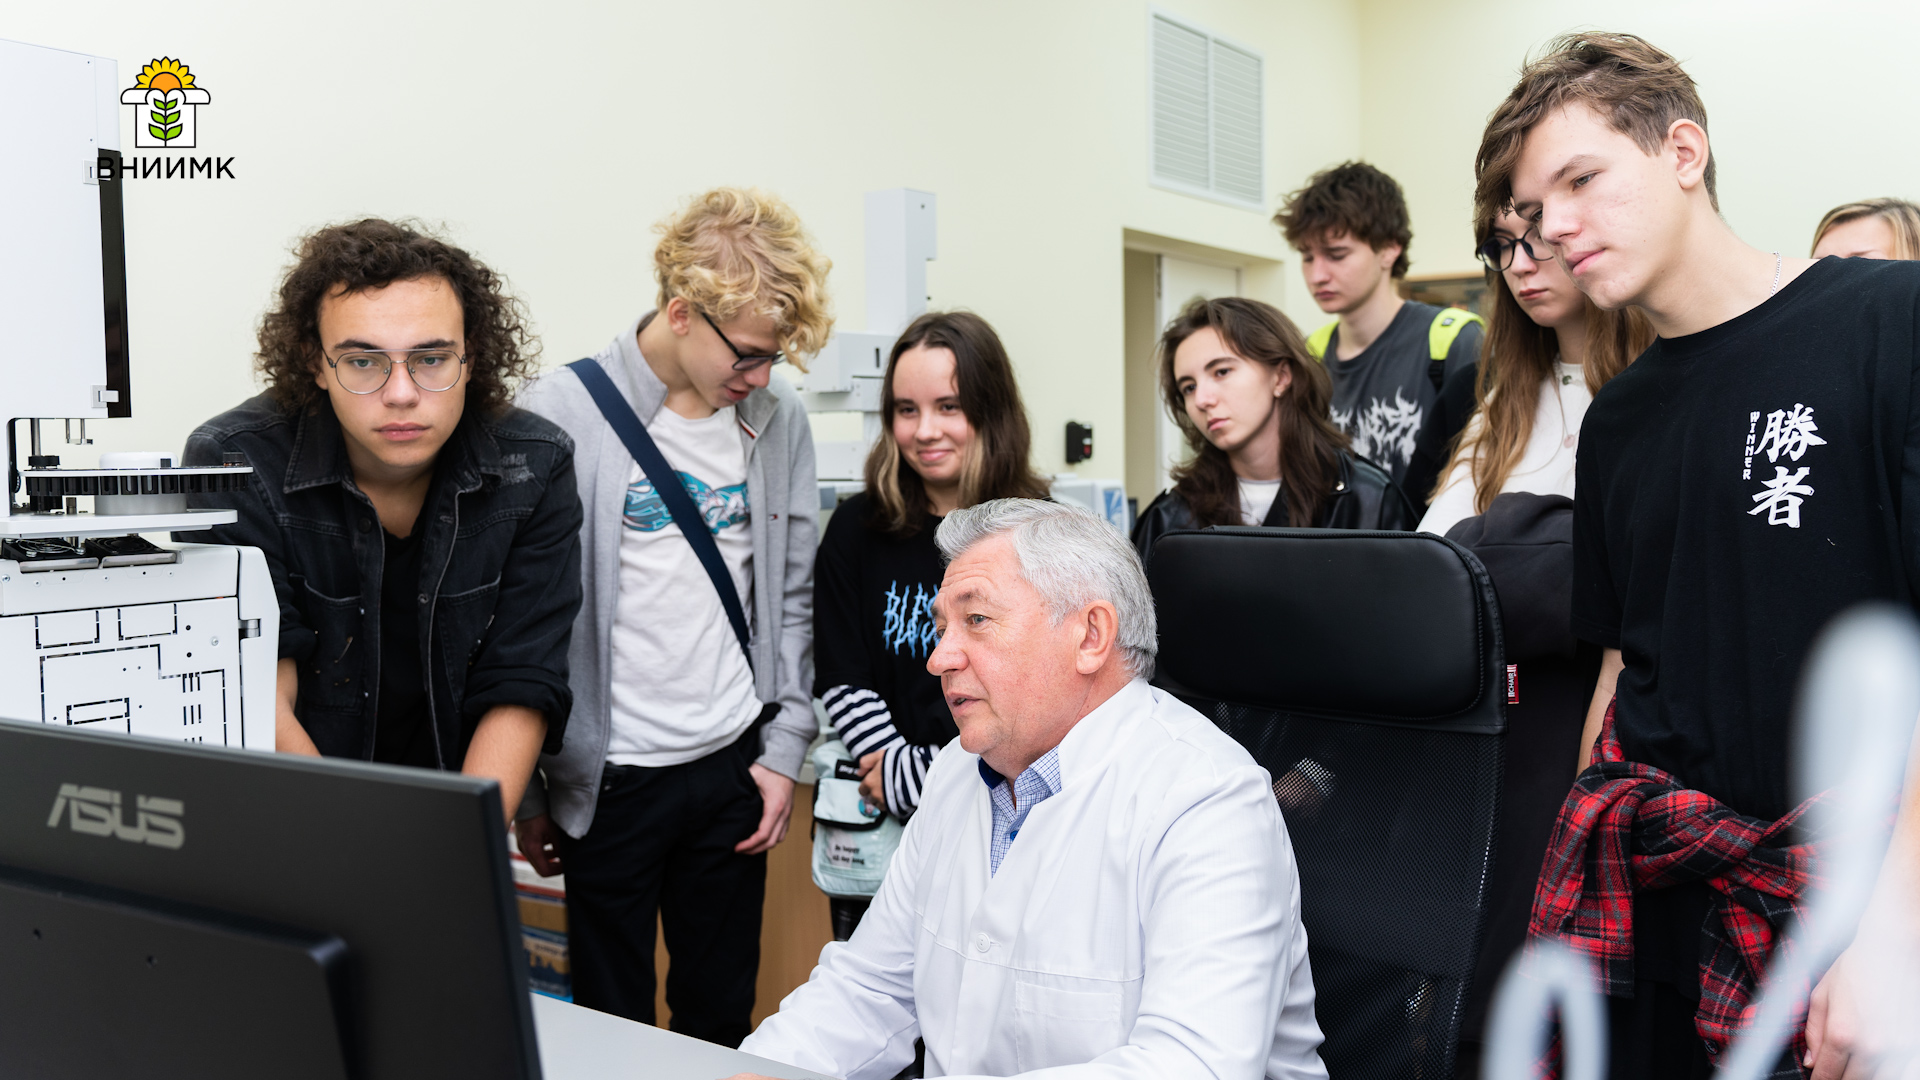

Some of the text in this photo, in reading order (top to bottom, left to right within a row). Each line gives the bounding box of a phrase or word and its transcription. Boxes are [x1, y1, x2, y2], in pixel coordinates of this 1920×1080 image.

[1743, 411, 1761, 480] WINNER
[1747, 403, 1827, 529] 勝者
[47, 783, 185, 850] ASUS
